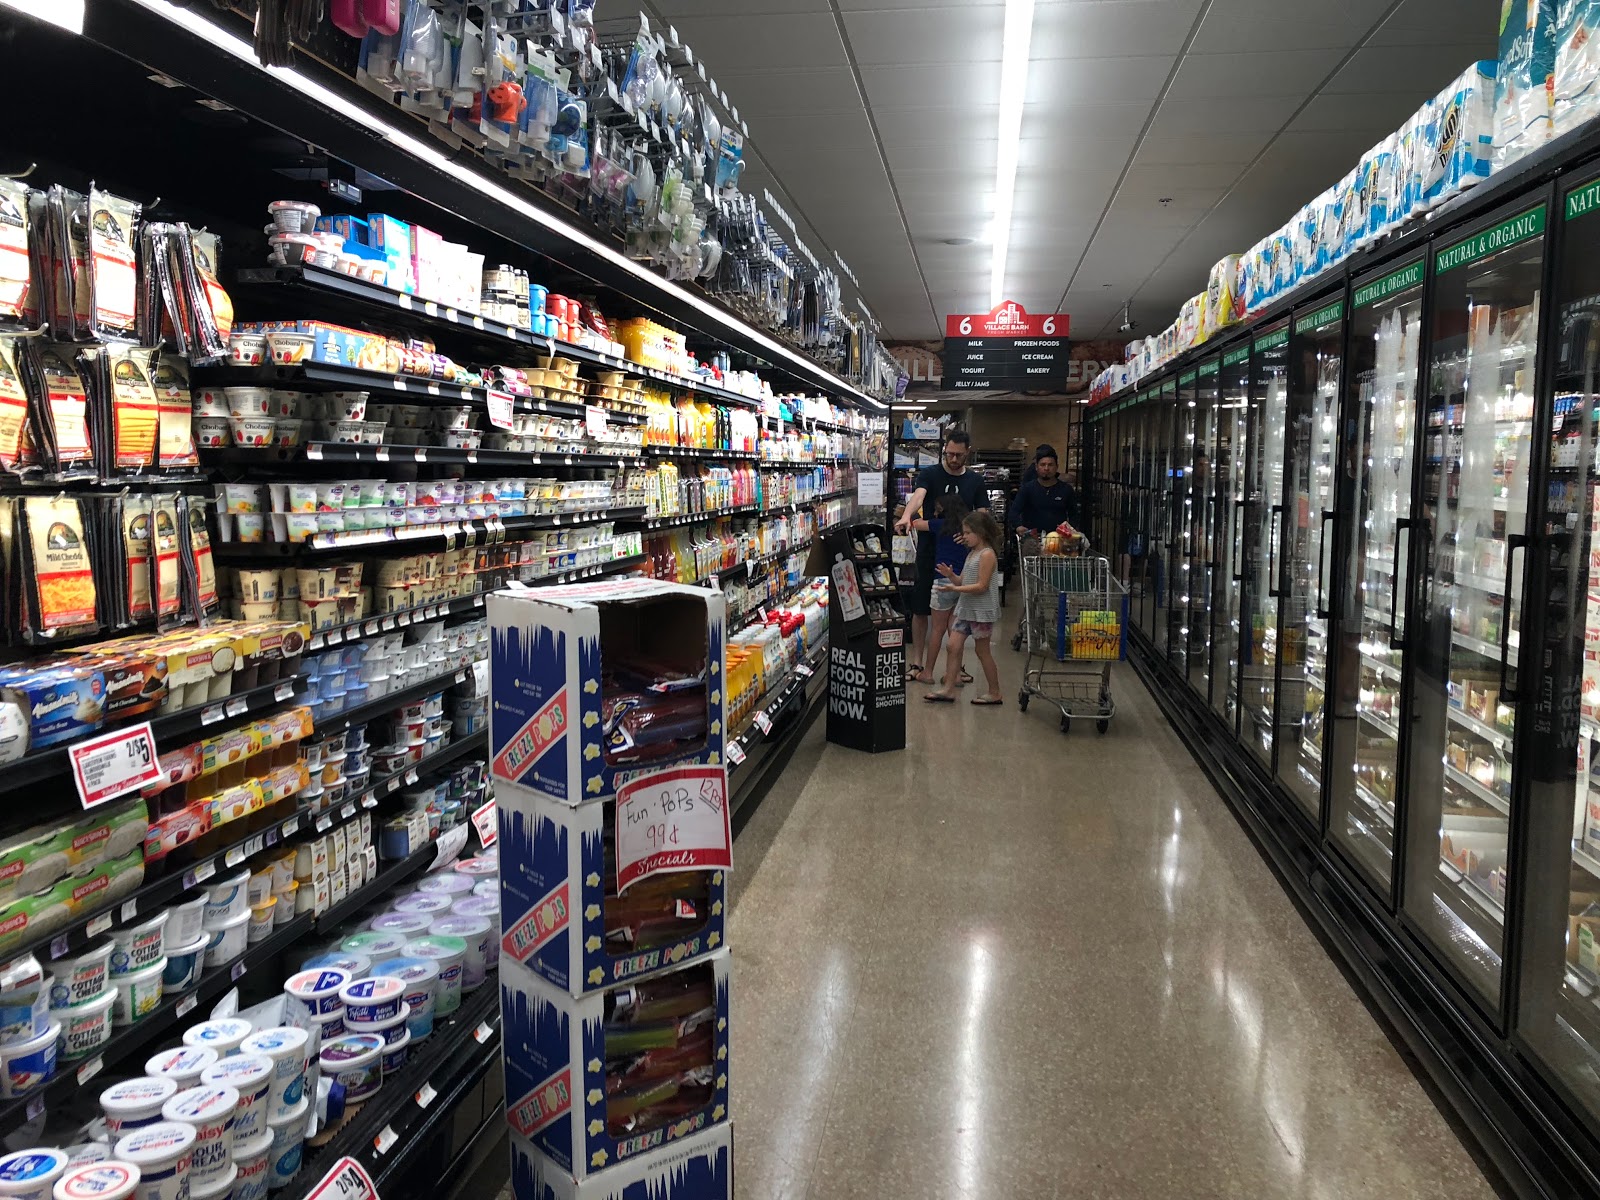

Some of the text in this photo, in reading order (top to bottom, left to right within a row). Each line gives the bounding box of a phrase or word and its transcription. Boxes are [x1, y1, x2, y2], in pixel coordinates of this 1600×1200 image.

[1438, 214, 1536, 272] NATURAL & ORGANIC
[1354, 268, 1418, 305] NATURAL & ORGANIC
[959, 316, 1056, 335] 6 6
[831, 646, 866, 670] REAL
[876, 652, 905, 666] FUEL
[831, 664, 869, 687] FOOD.
[876, 664, 898, 678] FOR
[830, 682, 865, 701] RIGHT
[876, 675, 901, 690] FIRE
[830, 701, 868, 722] NOW.
[876, 698, 905, 708] SMOOTHIE
[626, 800, 648, 827] Fun
[638, 851, 696, 874] Specials
[614, 950, 660, 979] FREEZE
[196, 1122, 225, 1141] aisy
[617, 1130, 663, 1159] FREEZE
[192, 1149, 226, 1168] REAM
